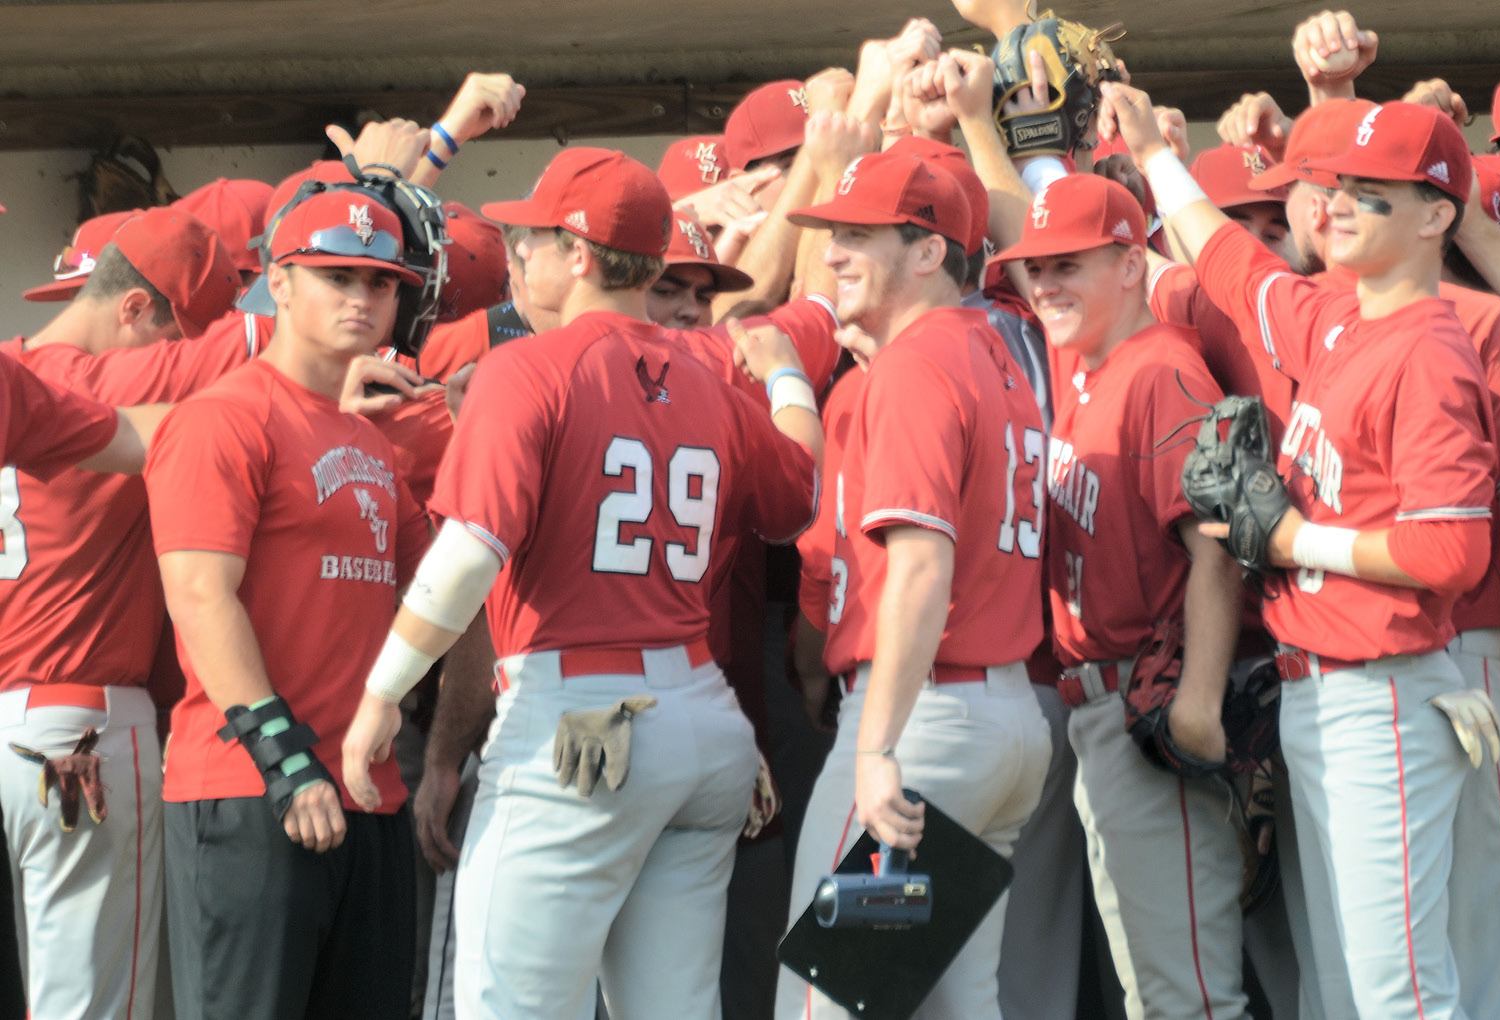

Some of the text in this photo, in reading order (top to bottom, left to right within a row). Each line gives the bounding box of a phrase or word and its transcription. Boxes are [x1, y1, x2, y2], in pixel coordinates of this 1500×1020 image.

[696, 142, 722, 185] MSU
[1016, 121, 1059, 143] SPALDING
[590, 434, 722, 584] 29
[997, 419, 1043, 559] 13
